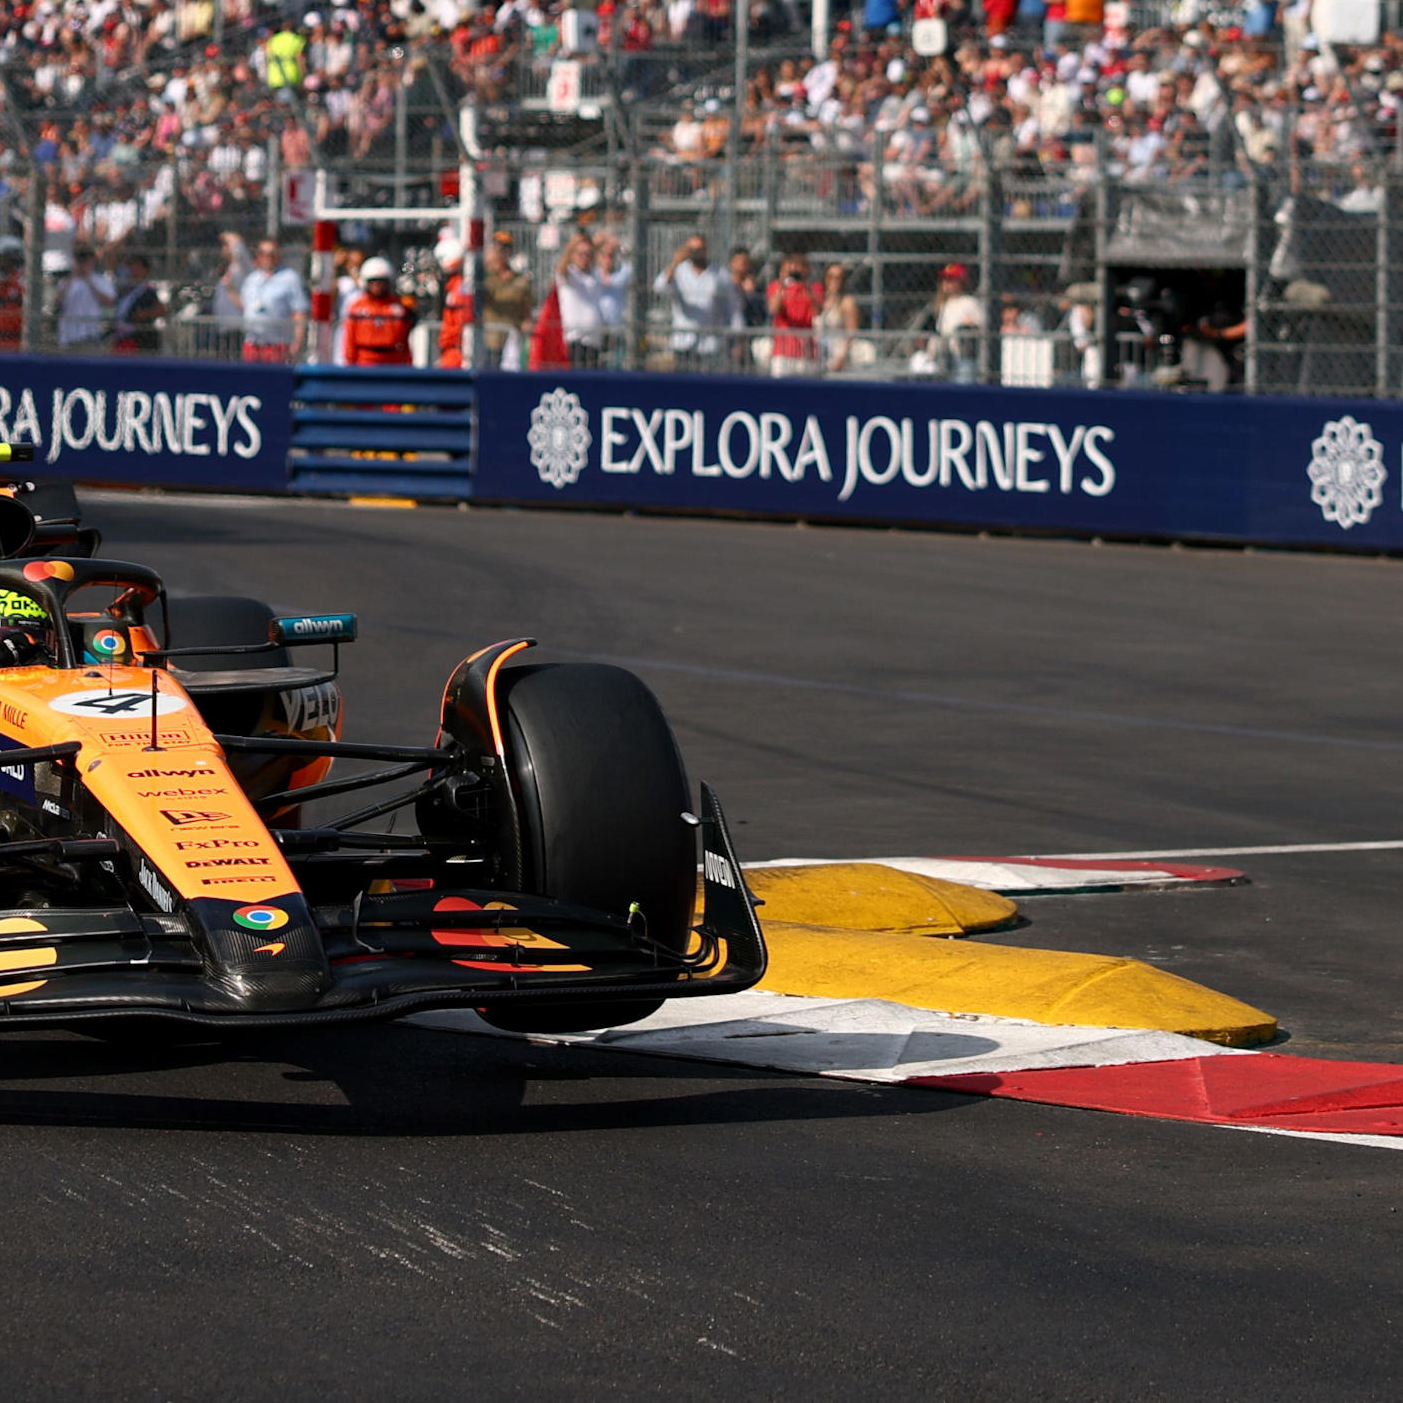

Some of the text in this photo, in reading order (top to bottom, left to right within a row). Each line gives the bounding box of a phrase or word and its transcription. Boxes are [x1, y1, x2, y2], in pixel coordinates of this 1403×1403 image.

[47, 388, 262, 462] JOURNEYS
[600, 405, 1117, 502] EXPLORA JOURNEYS
[294, 618, 343, 636] allwyn
[73, 693, 153, 714] 4
[3, 703, 28, 729] MILLE
[127, 769, 216, 778] allwyn
[137, 787, 229, 798] webex
[175, 839, 260, 850] FxPro
